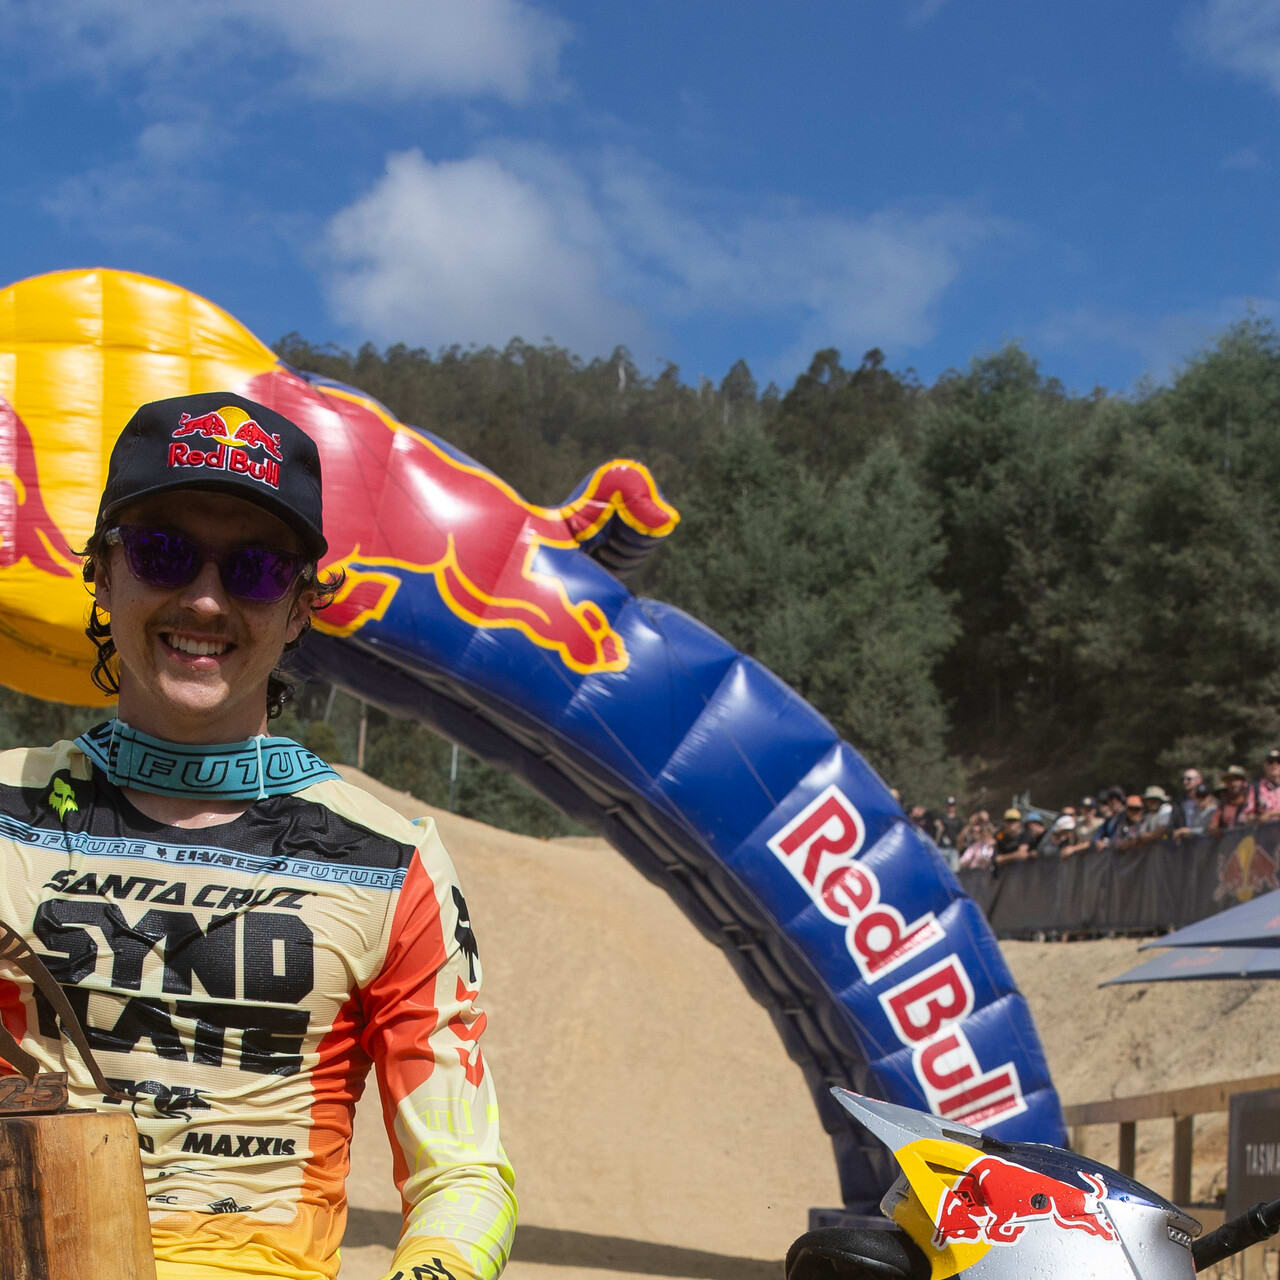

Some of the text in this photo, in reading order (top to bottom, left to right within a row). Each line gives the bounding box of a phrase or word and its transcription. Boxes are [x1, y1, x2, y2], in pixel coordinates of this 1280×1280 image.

[168, 441, 281, 489] Red Bull
[42, 834, 146, 855] FUTURE
[42, 870, 310, 910] SANTA CRUZ
[32, 898, 315, 1005] SYND
[774, 790, 1023, 1130] Red Bull
[181, 1131, 297, 1158] MAXXIS
